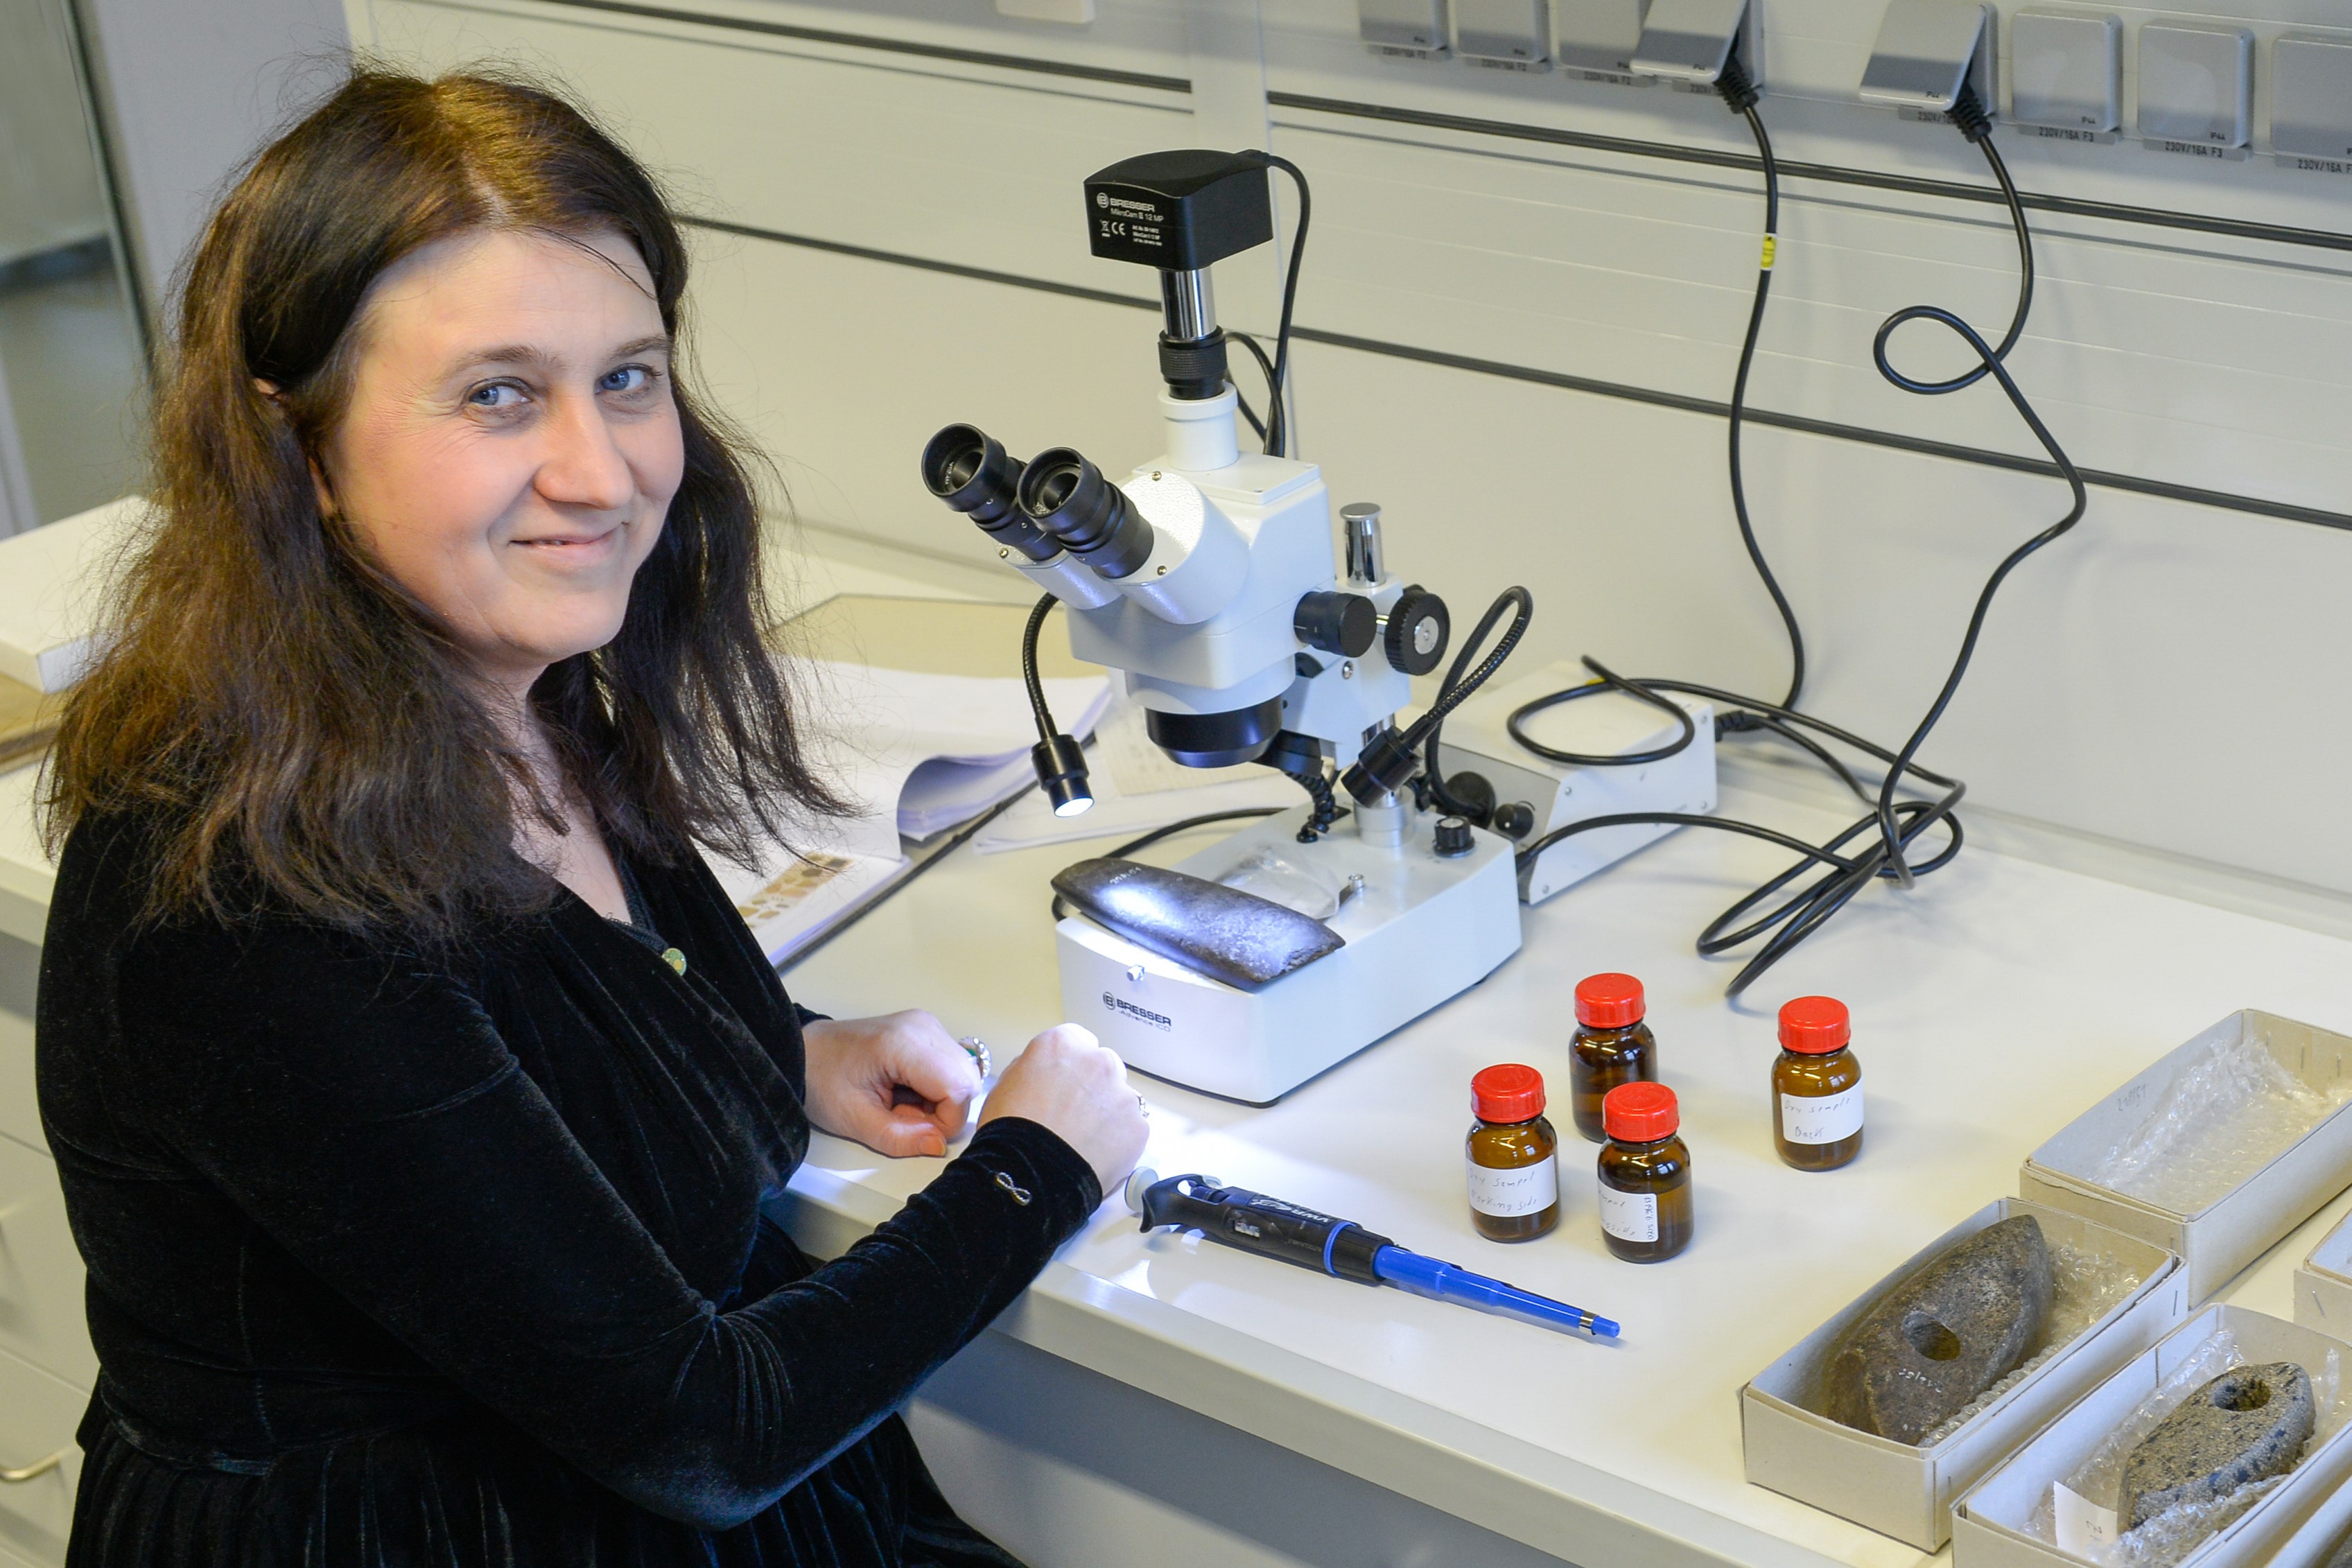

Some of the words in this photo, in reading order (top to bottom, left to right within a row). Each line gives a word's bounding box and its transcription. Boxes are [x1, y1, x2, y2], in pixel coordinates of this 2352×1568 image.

[2165, 141, 2207, 156] 230V/16A
[2211, 147, 2222, 158] F3
[2298, 159, 2342, 173] 230V/16A
[1110, 198, 1155, 212] BRESSER
[1116, 998, 1171, 1027] BRESSER
[1291, 1209, 1329, 1223] VWR
